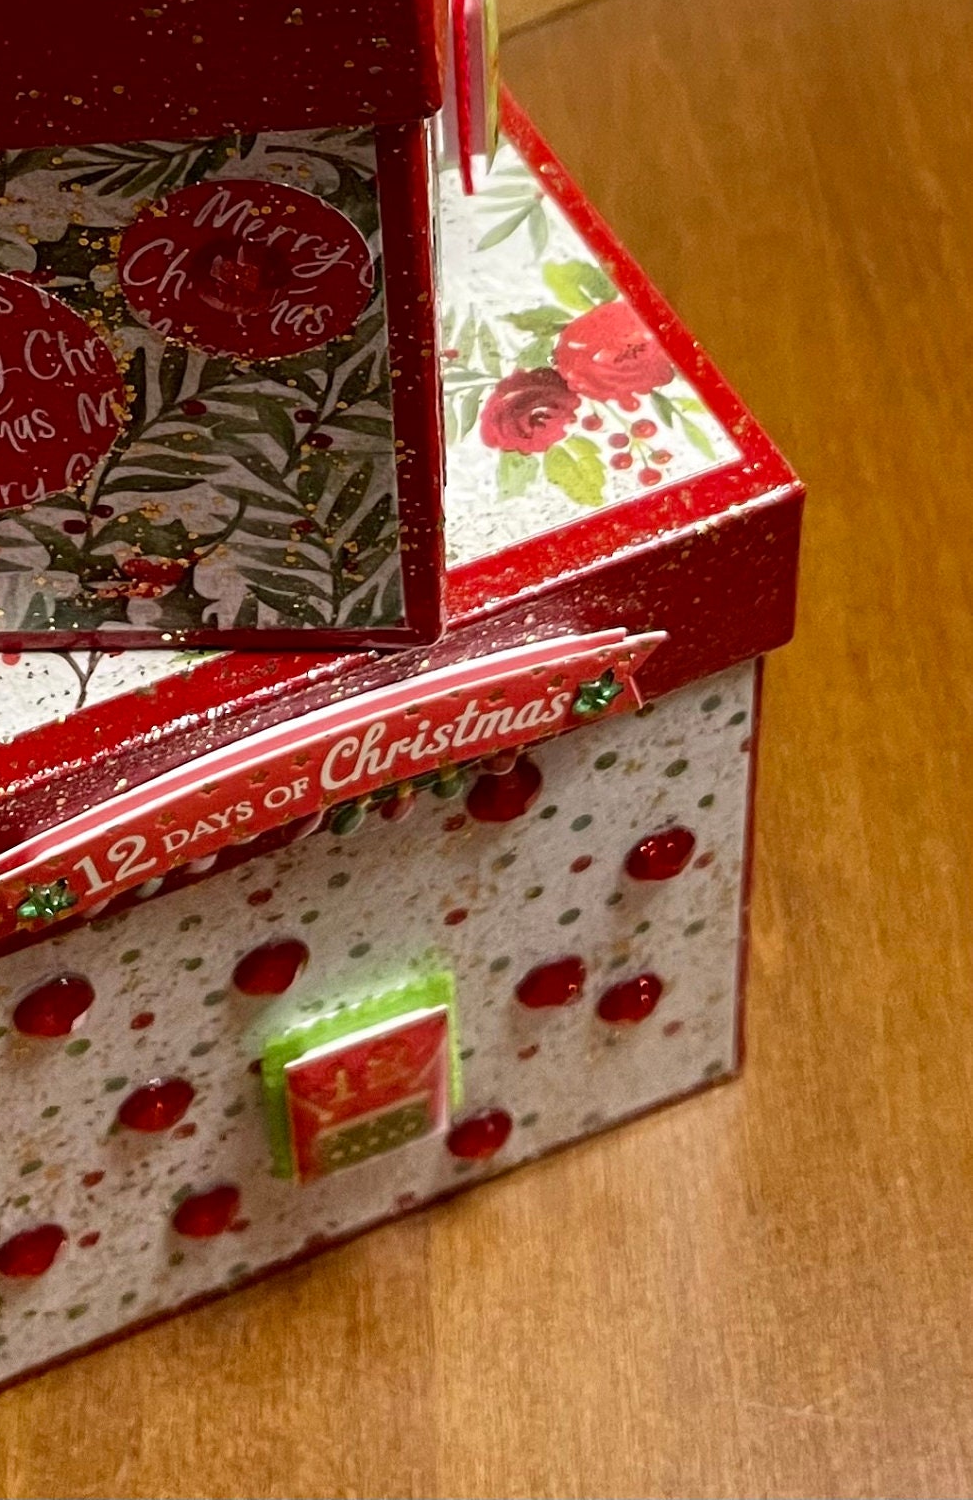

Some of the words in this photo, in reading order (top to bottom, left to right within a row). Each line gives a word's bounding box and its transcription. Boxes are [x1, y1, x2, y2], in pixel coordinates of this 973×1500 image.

[193, 190, 355, 278] Merry
[72, 836, 158, 898] 12
[163, 800, 255, 855] DAYS
[263, 776, 310, 809] OF
[320, 691, 571, 791] Christmas
